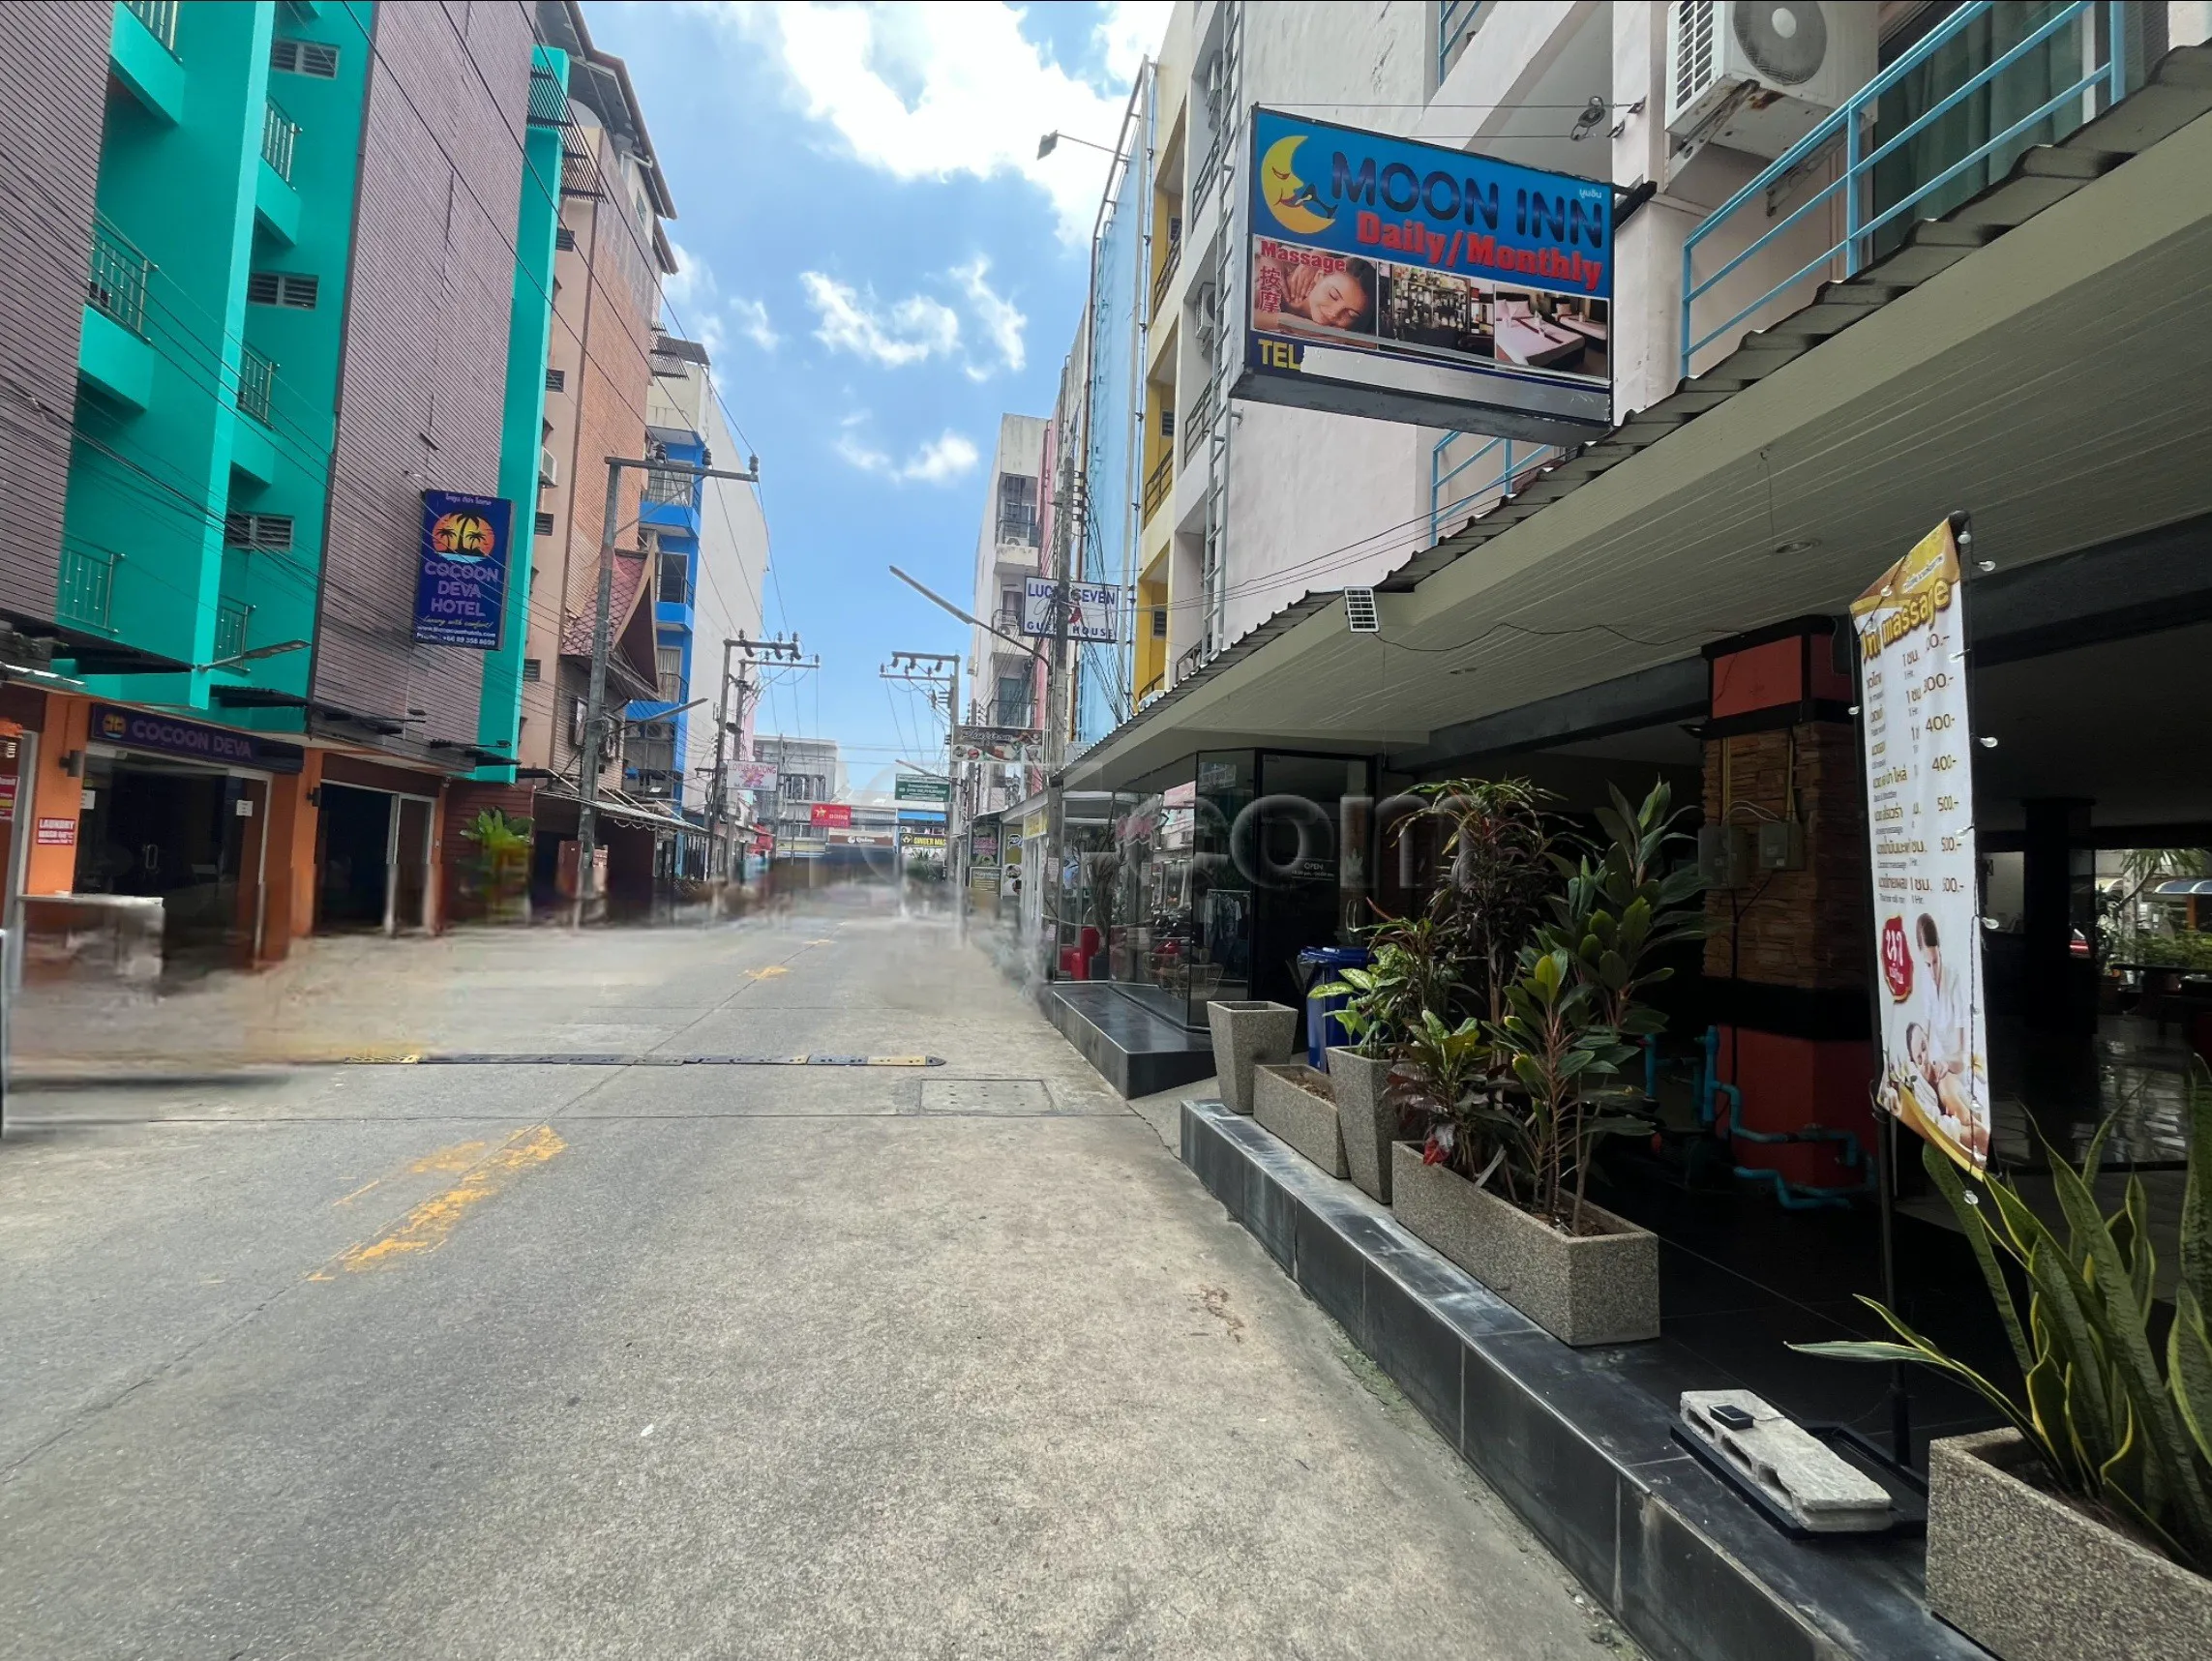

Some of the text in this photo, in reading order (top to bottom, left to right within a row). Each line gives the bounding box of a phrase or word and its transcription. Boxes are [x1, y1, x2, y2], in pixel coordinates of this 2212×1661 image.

[1331, 151, 1602, 248] MOON INN
[1260, 240, 1347, 274] Massage
[1357, 209, 1602, 292] Daily/Monthly
[1258, 266, 1281, 313] 按摩
[1258, 339, 1301, 371] TEL
[425, 561, 499, 582] COCOON
[437, 580, 482, 599] DEVA
[431, 597, 486, 617] HOTEL
[133, 720, 252, 758] COCOON DEVA
[729, 761, 777, 775] LOTUS PATONG
[913, 837, 934, 846] GINGER
[1303, 861, 1324, 871] OPEN
